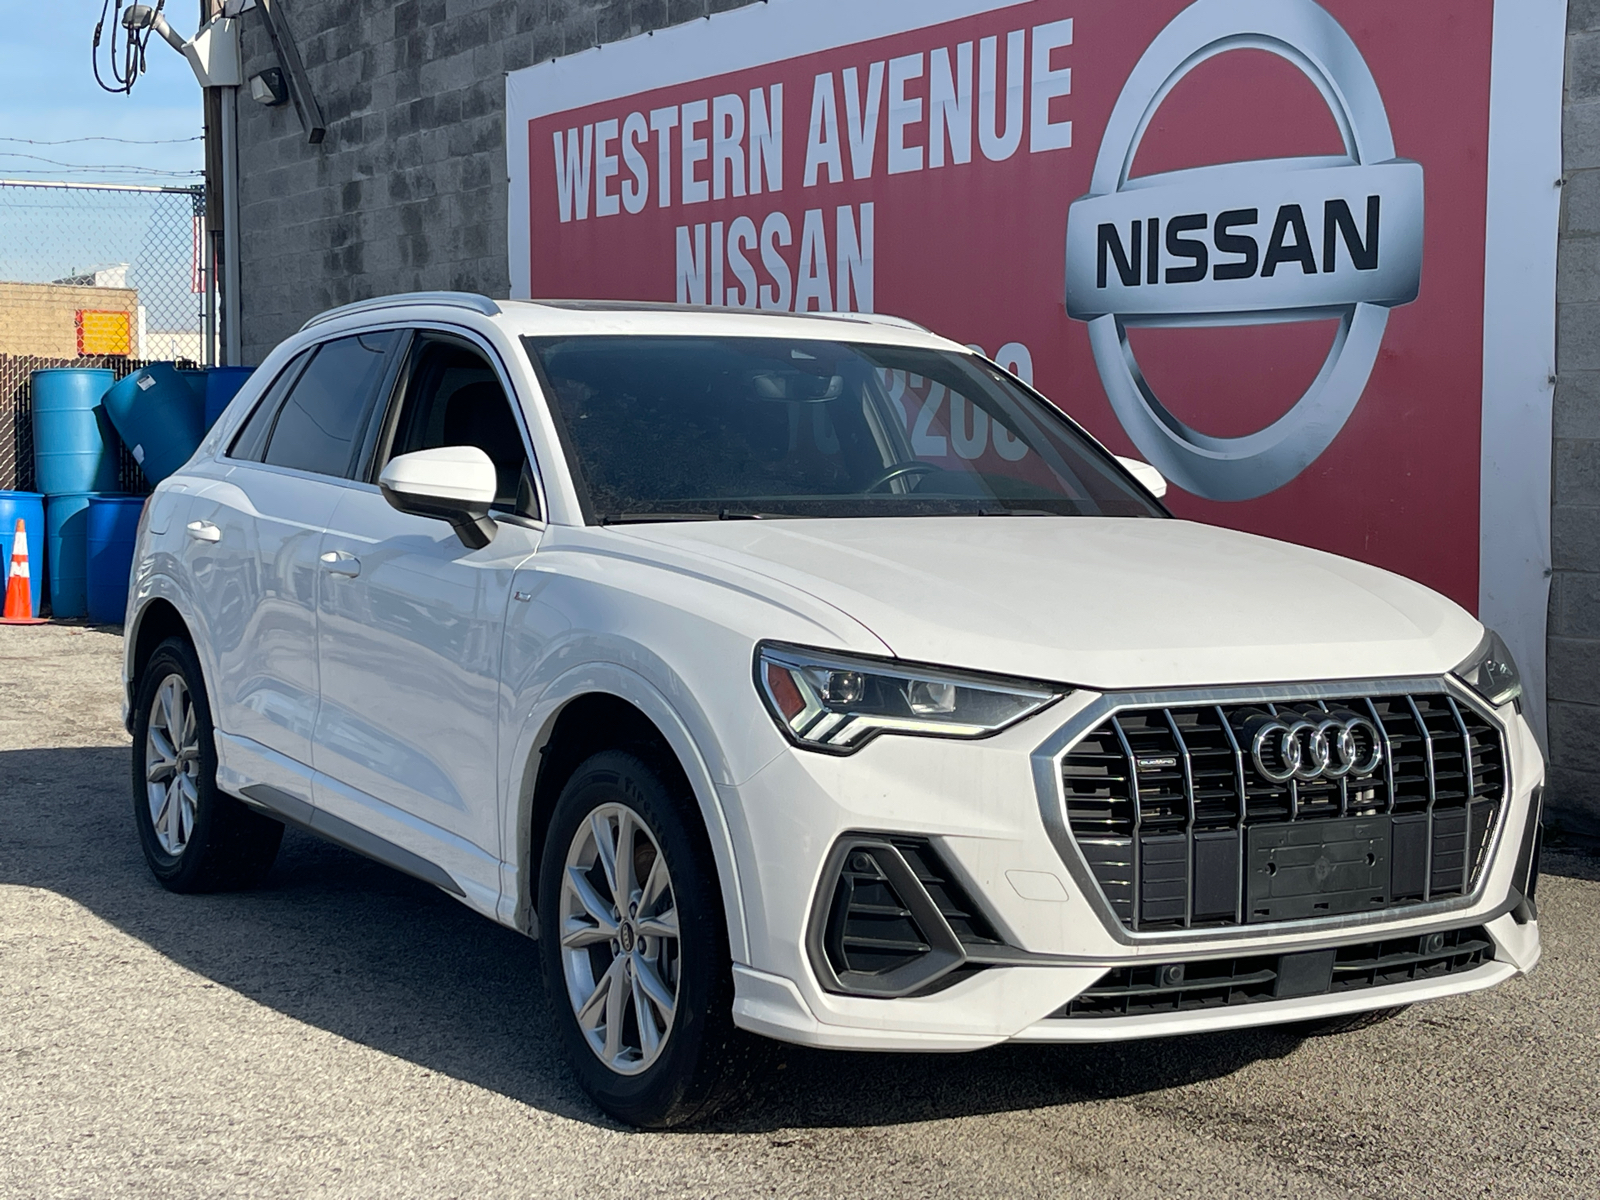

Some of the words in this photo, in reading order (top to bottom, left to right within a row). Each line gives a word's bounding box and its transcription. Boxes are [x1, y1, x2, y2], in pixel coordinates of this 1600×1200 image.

[553, 83, 784, 223] WESTERN
[803, 18, 1074, 187] AVENUE
[676, 202, 875, 314] NISSAN
[1096, 195, 1380, 289] NISSAN
